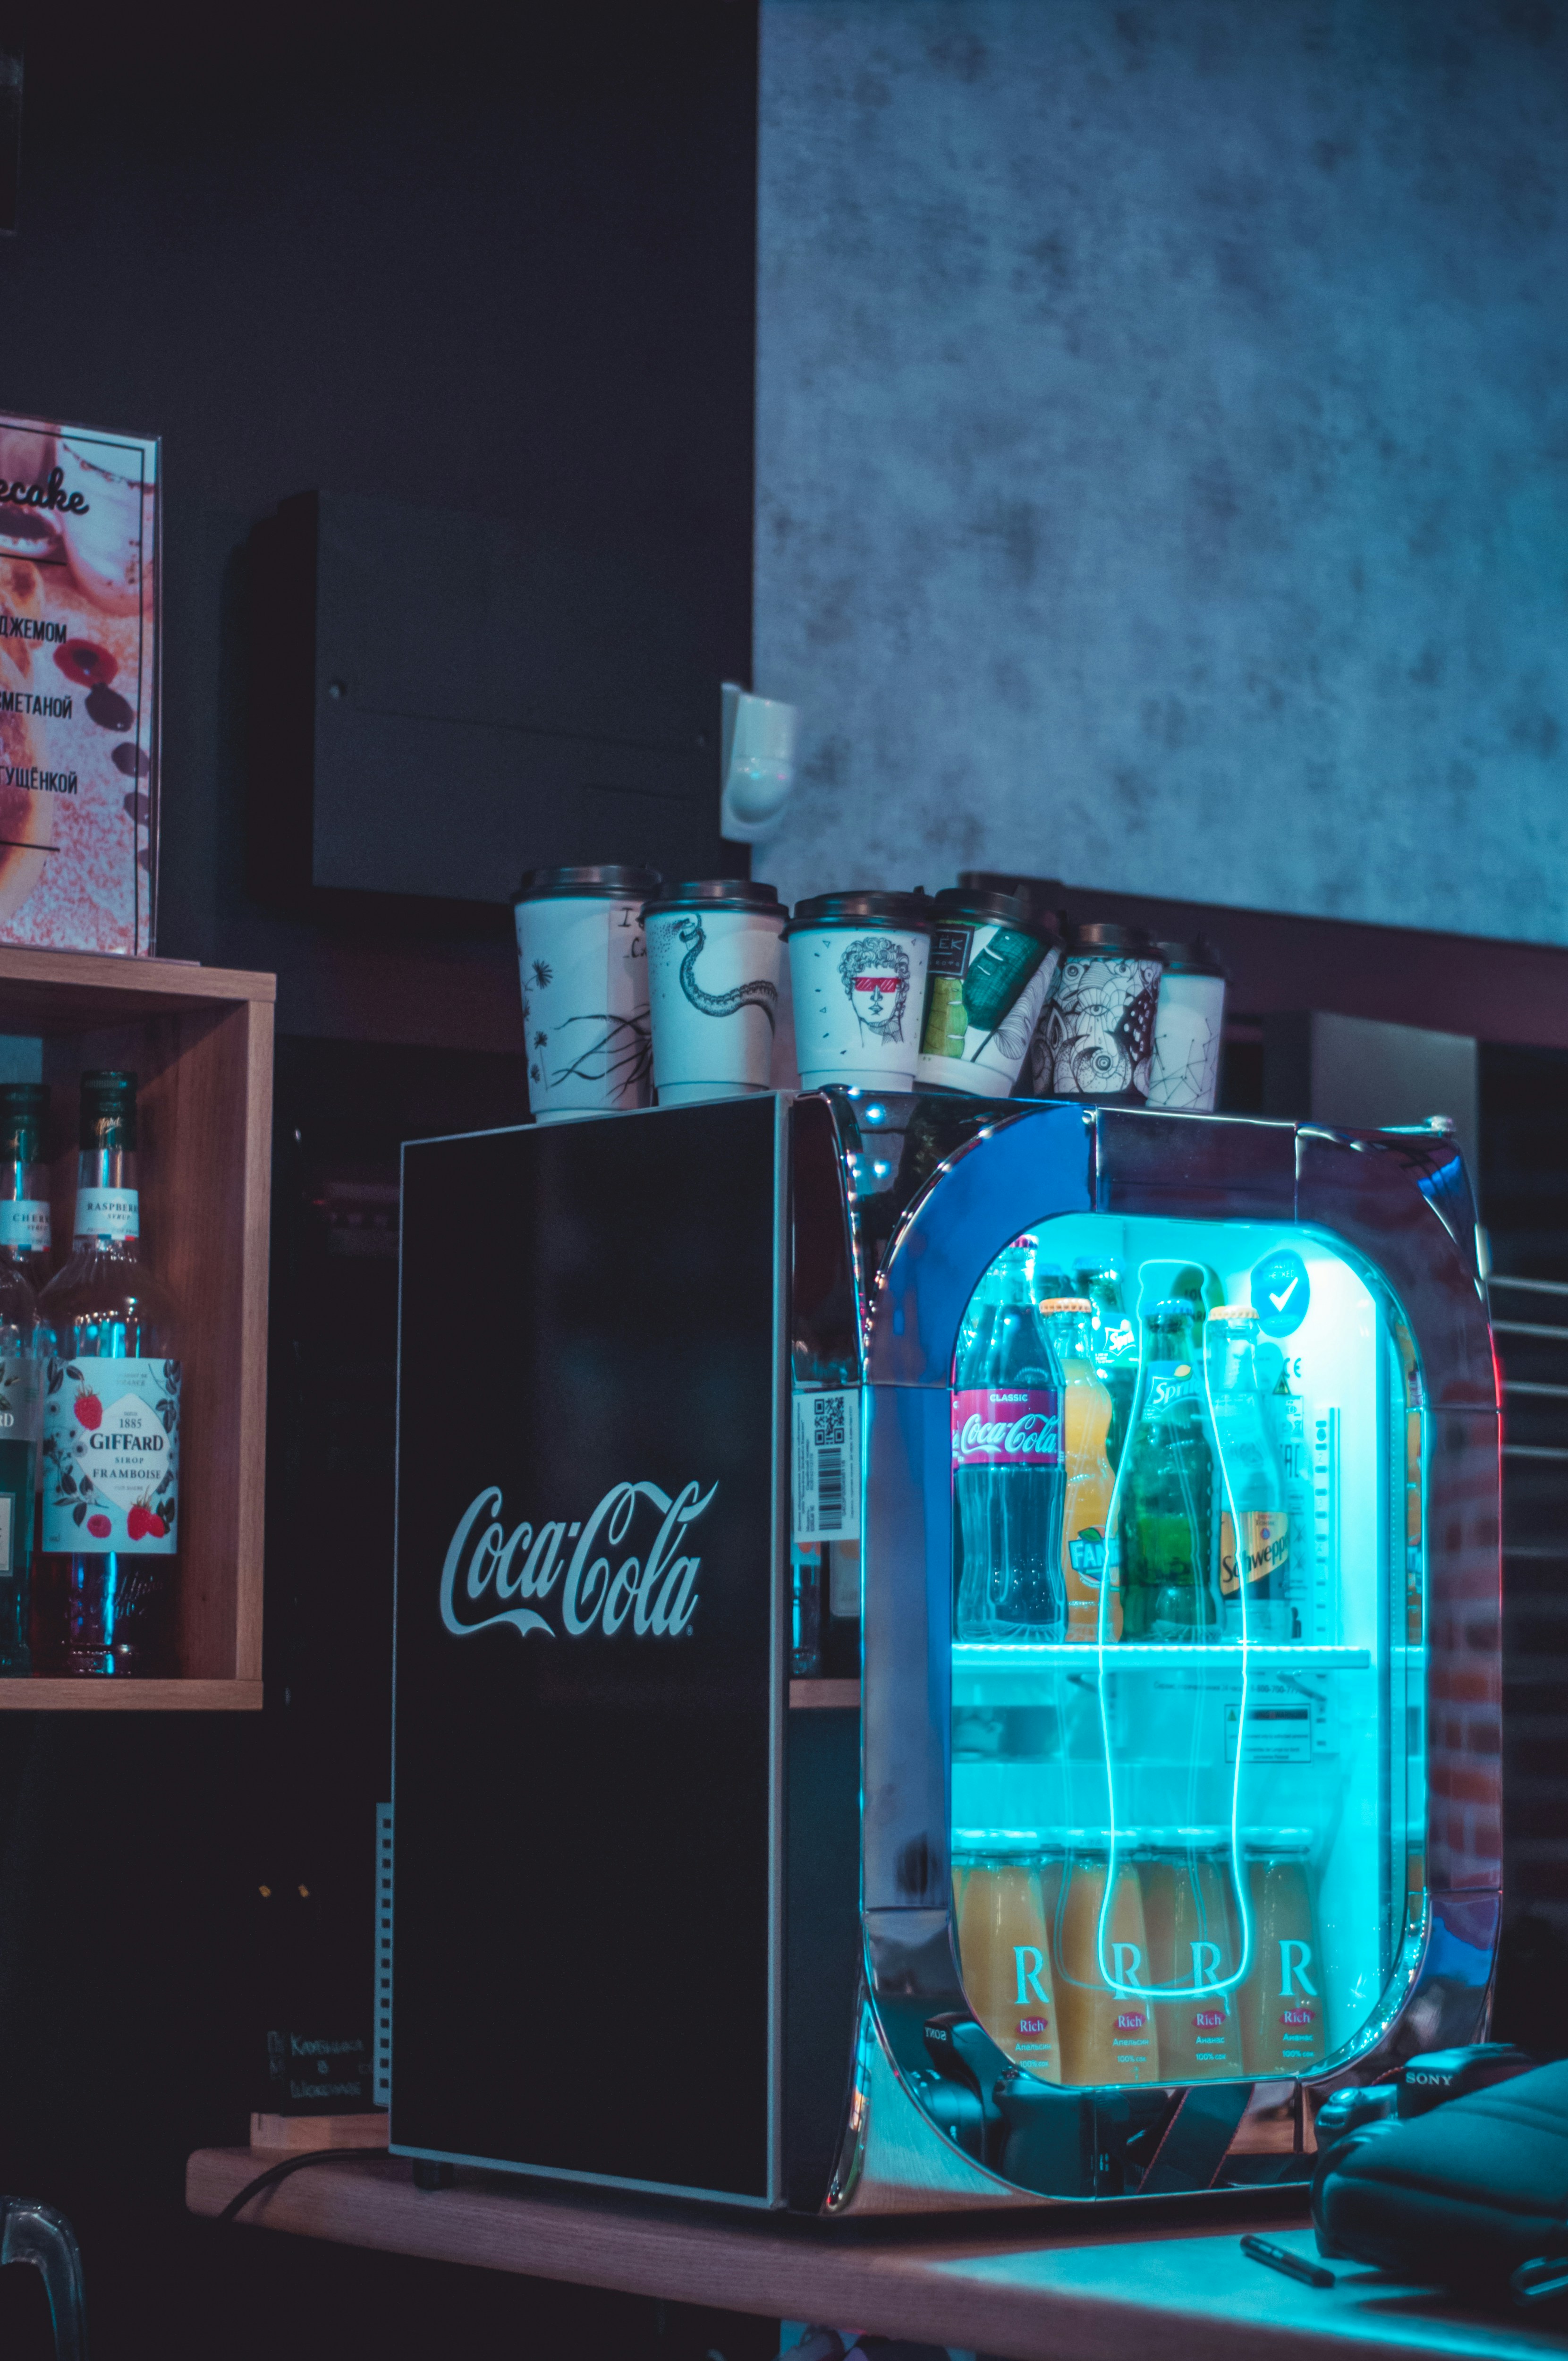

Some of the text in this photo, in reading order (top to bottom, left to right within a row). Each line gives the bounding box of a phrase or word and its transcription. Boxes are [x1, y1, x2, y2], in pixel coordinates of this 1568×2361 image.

[0, 615, 67, 643] ДЖЕМОМ
[0, 690, 72, 719] МЕТАНОЙ
[990, 1394, 1028, 1402] CLASSIC
[120, 1418, 142, 1428] 1885
[961, 1413, 1059, 1454] Coca-Cola
[90, 1434, 164, 1451] GIFFARD
[93, 1469, 161, 1479] FRAMBOISE
[440, 1479, 719, 1637] Coca-Cola
[1111, 1943, 1147, 2000] R
[1190, 1941, 1227, 1998] R
[1278, 1940, 1317, 1996] R
[1013, 1946, 1050, 2004] R
[1118, 2015, 1142, 2028] Rich
[1196, 2013, 1222, 2025] Rich
[1284, 2010, 1311, 2023] Rich
[1020, 2019, 1044, 2032] Rich
[1112, 2038, 1149, 2046] Апельсин
[1196, 2036, 1225, 2044] Ананас
[1282, 2032, 1313, 2041] Ананас
[1015, 2042, 1051, 2051] Апельсин
[1117, 2055, 1135, 2063] 100%
[1282, 2050, 1301, 2058] 100%
[1406, 2072, 1454, 2086] SONY
